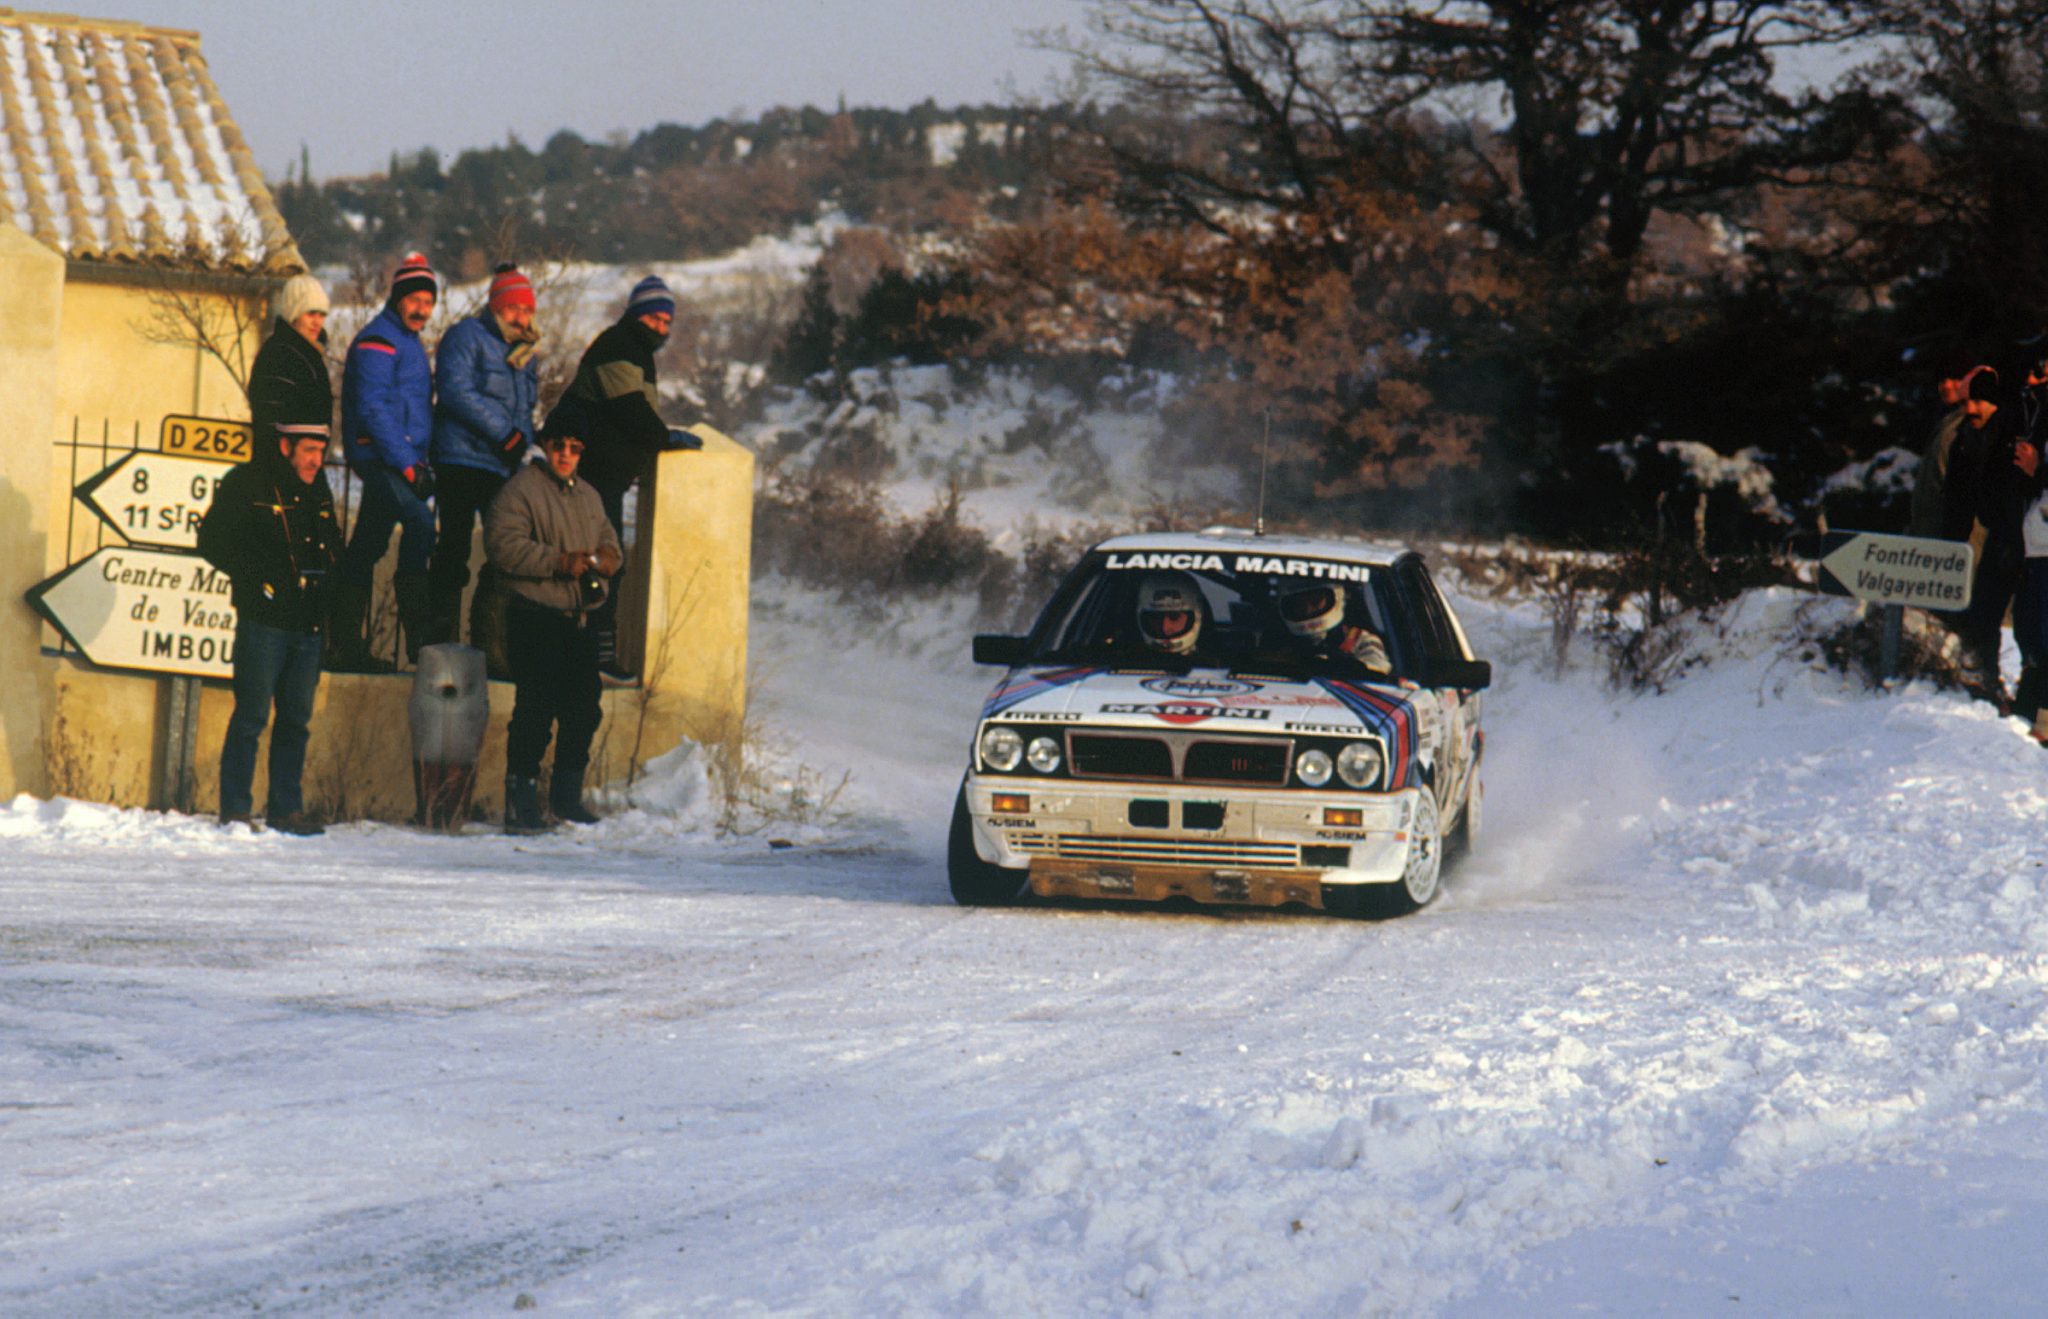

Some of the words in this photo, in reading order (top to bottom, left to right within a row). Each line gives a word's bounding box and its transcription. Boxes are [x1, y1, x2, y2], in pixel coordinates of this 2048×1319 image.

[169, 424, 187, 449] D
[193, 427, 248, 457] 262
[132, 468, 149, 494] 8
[123, 503, 150, 529] 11
[102, 556, 182, 590] Centre
[1105, 553, 1224, 571] LANCIA
[1235, 557, 1371, 584] MARTINI
[1864, 543, 1966, 573] Fontfreyde
[1857, 569, 1964, 600] Valgayettes
[130, 594, 159, 622] de
[1104, 704, 1268, 720] MARTINI
